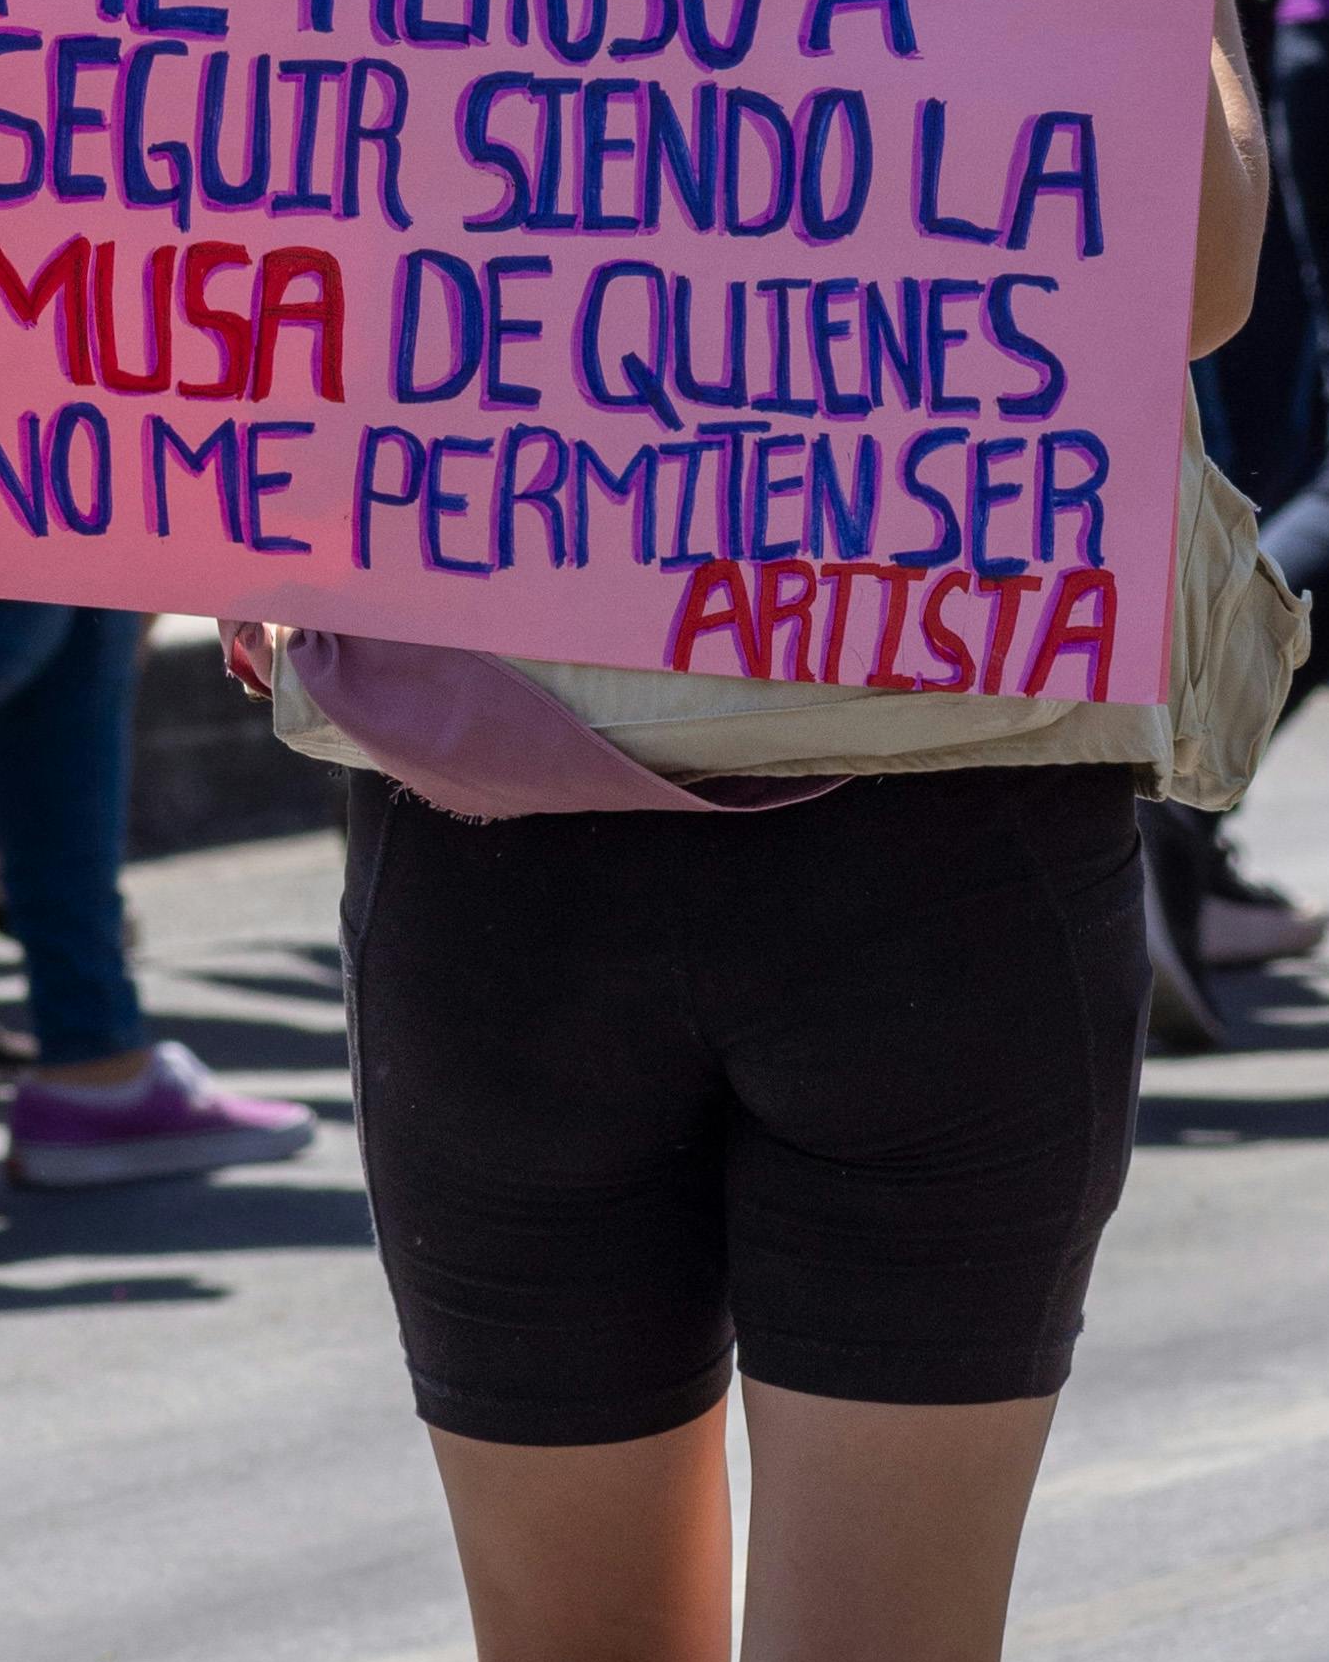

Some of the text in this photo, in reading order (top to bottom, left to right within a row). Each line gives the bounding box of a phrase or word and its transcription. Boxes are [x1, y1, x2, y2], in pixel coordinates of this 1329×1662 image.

[455, 69, 874, 247] SIENDO
[911, 96, 1106, 260] LA
[388, 250, 553, 412] DE
[571, 258, 1068, 432] QUIENES
[141, 413, 316, 556] ME
[350, 419, 883, 576] PERMITEN
[889, 425, 1109, 579] SER
[667, 557, 1118, 699] ARTISTA
